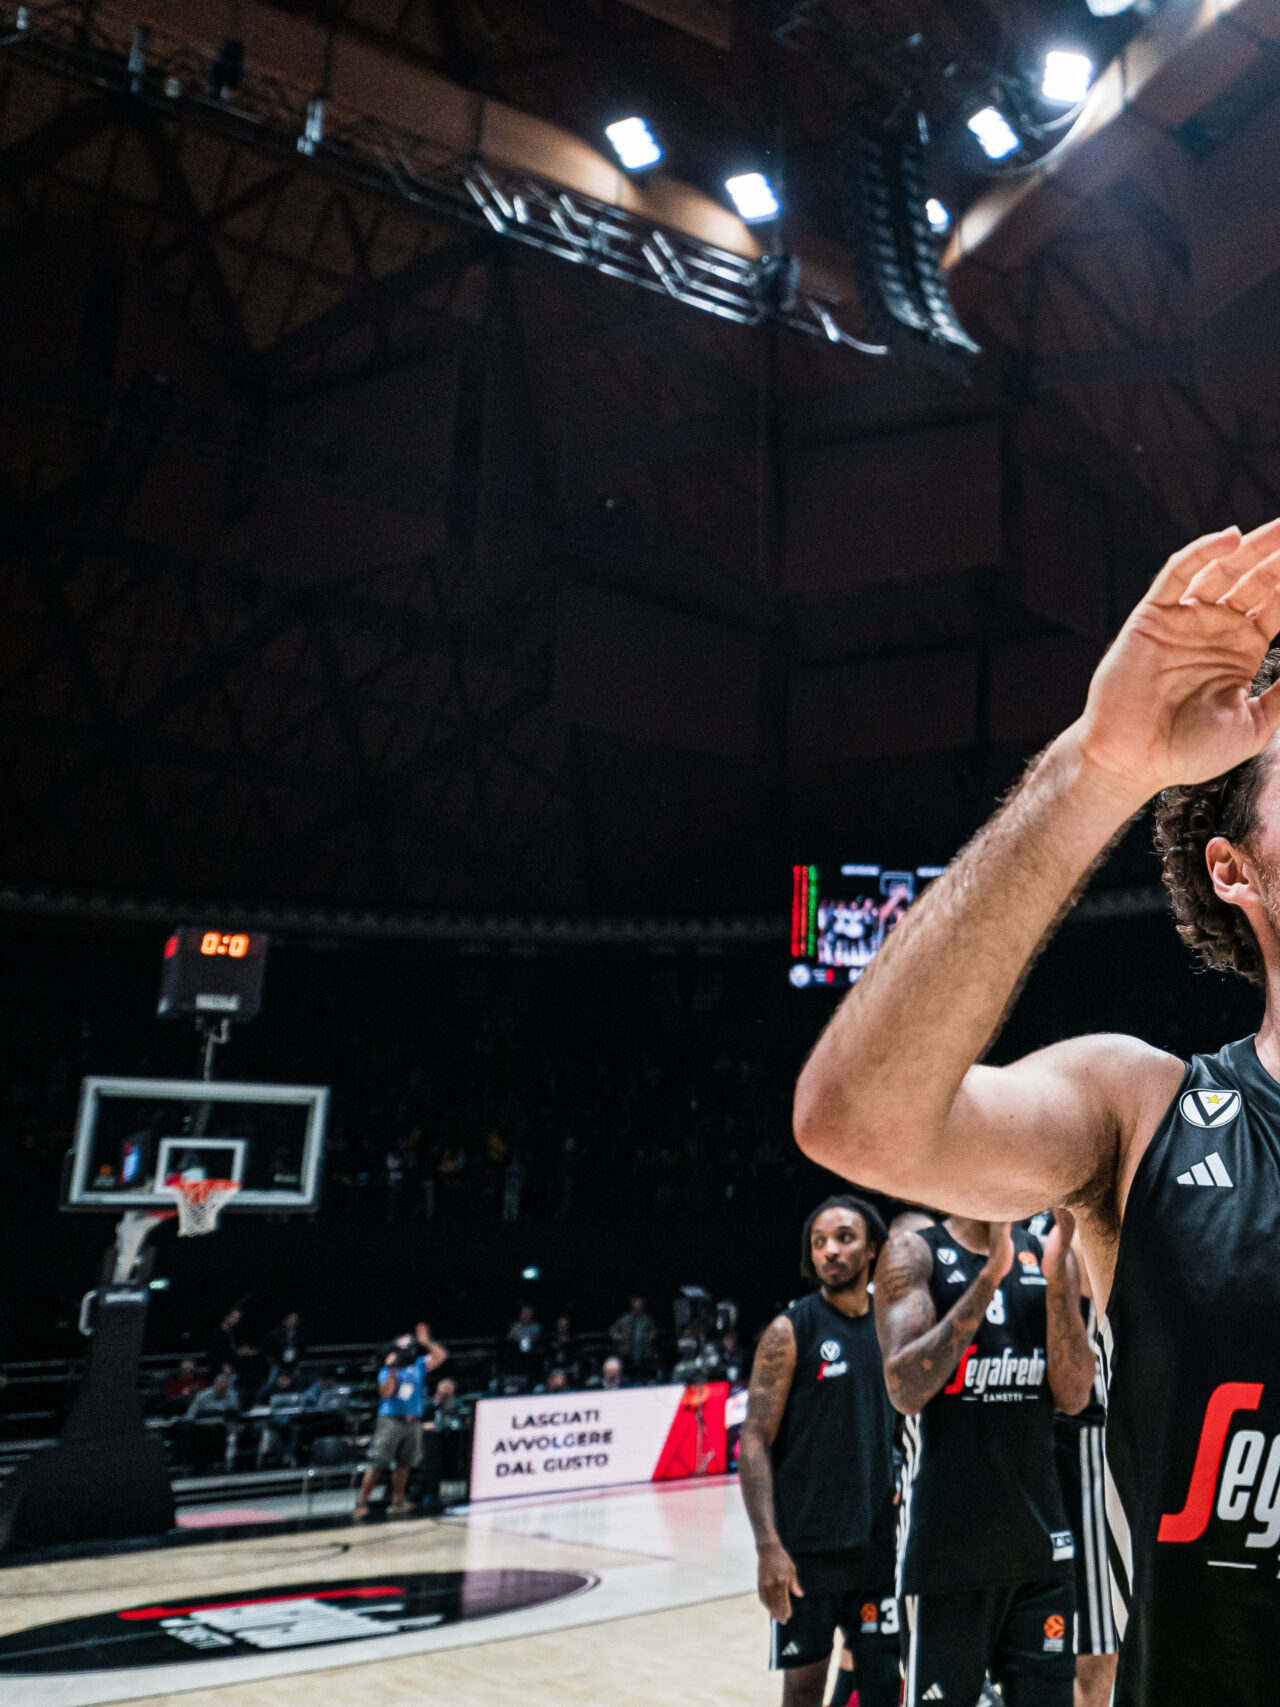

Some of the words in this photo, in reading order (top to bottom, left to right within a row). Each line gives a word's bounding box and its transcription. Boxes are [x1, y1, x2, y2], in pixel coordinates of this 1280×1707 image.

[512, 1410, 600, 1429] LASCIATI
[493, 1429, 613, 1454] AVVOLGERE
[496, 1460, 535, 1477] DAL
[543, 1454, 609, 1473] GUSTO
